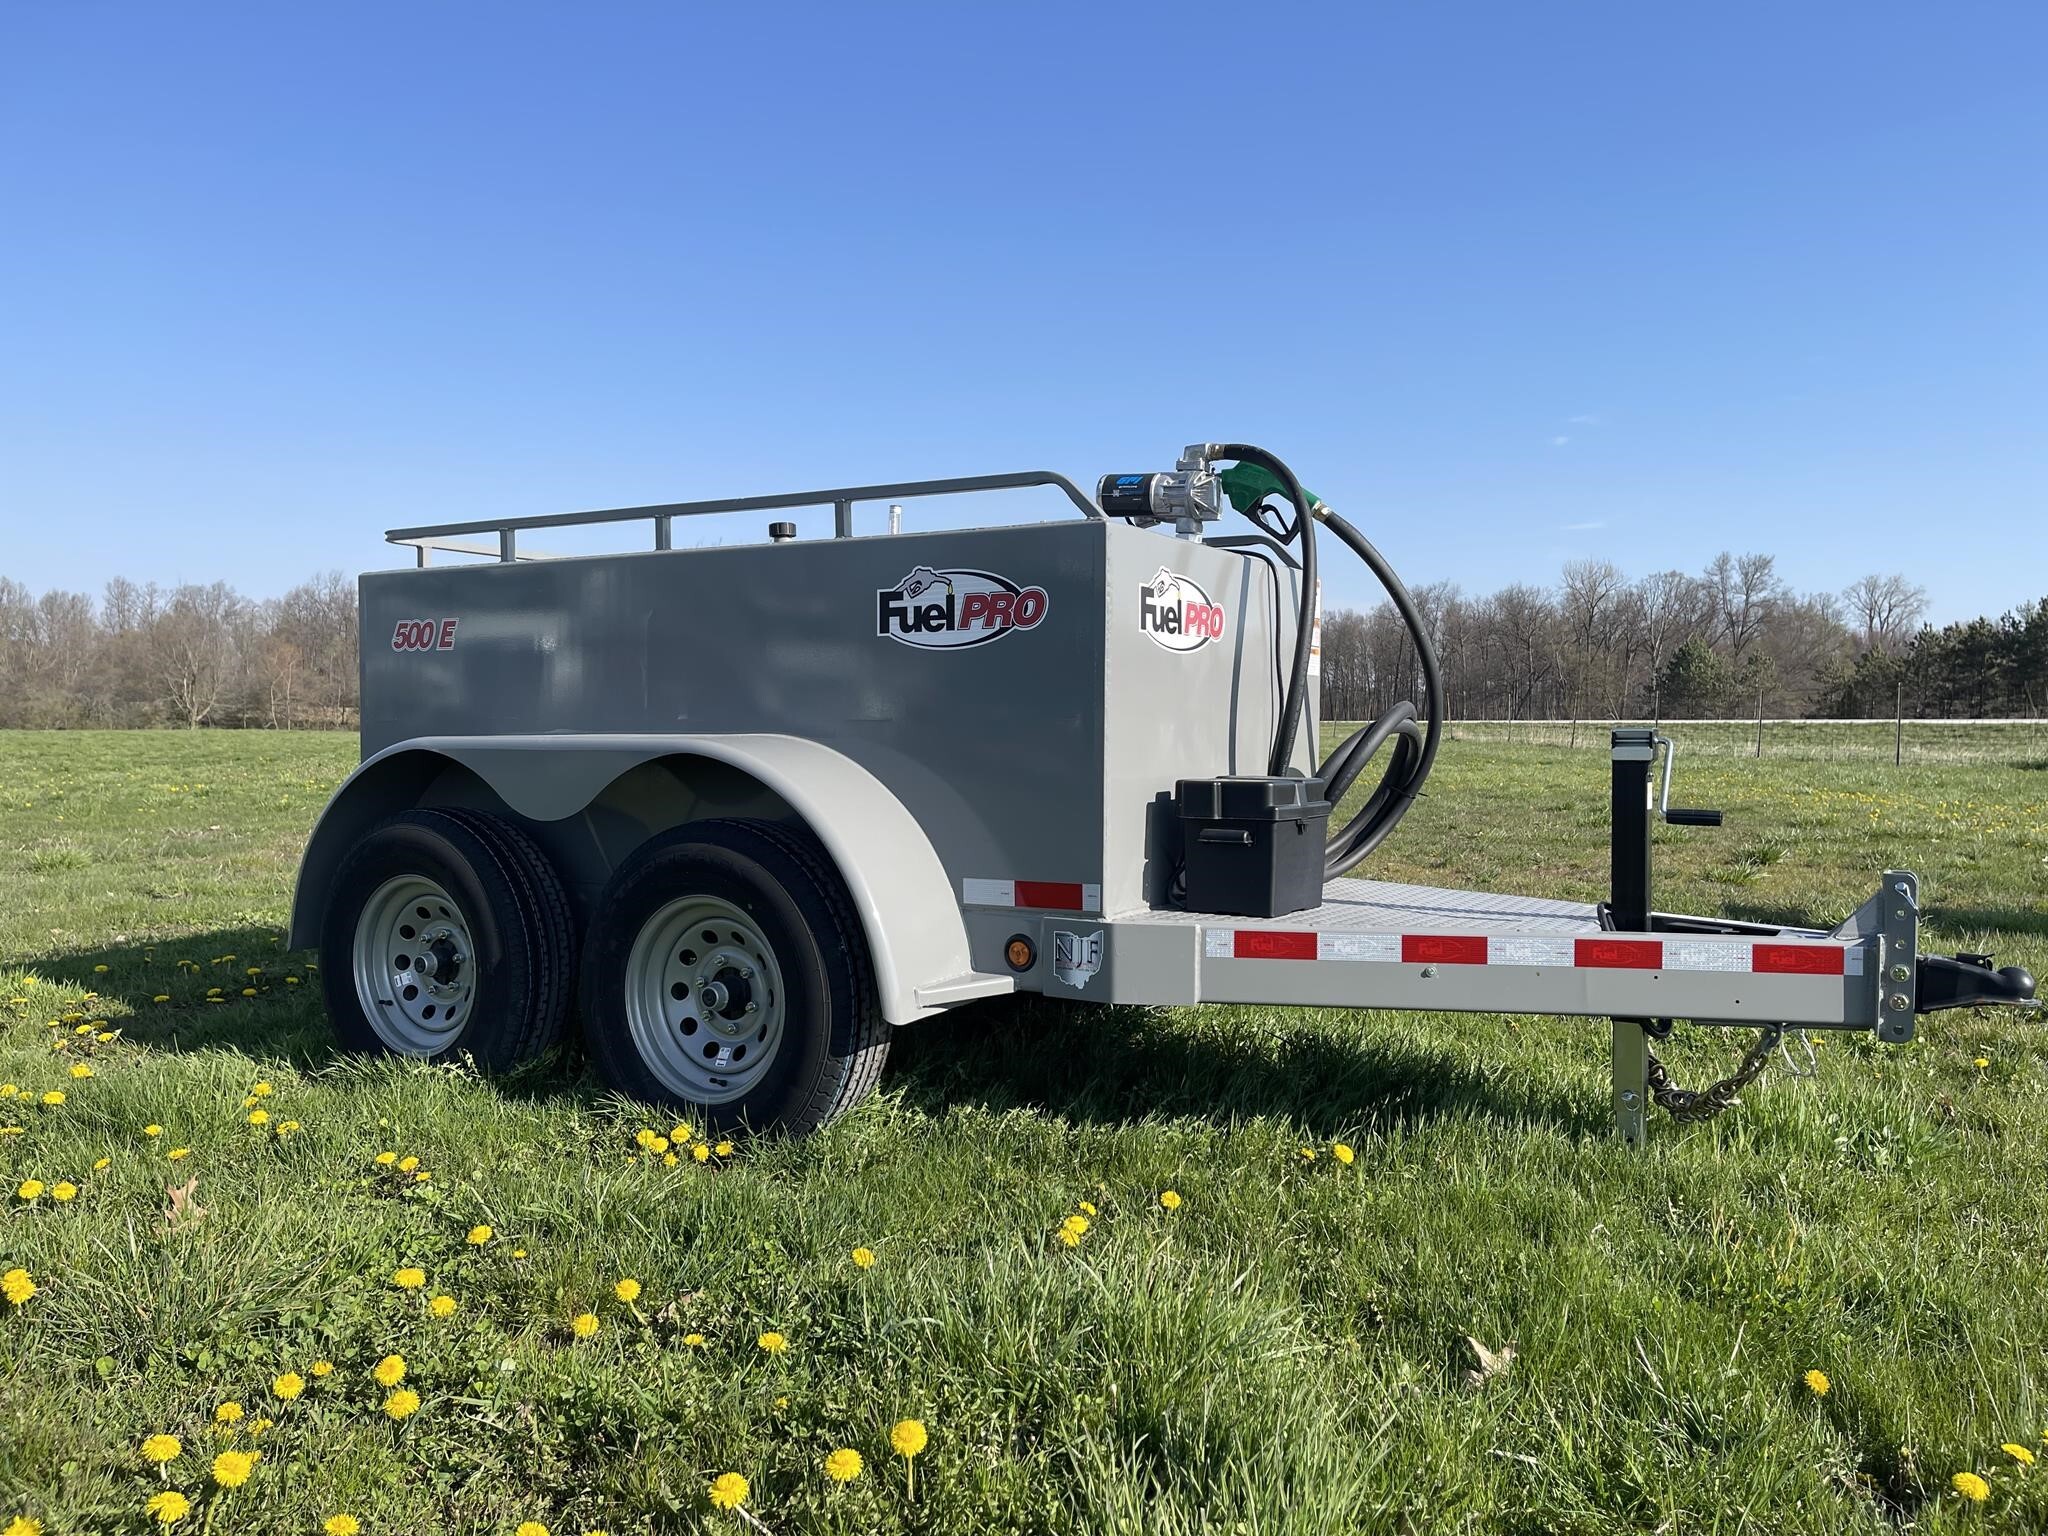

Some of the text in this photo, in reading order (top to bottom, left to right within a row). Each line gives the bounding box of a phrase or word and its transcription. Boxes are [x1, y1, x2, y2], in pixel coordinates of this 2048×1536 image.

[392, 619, 458, 651] 500 E
[1055, 938, 1099, 968] NJF
